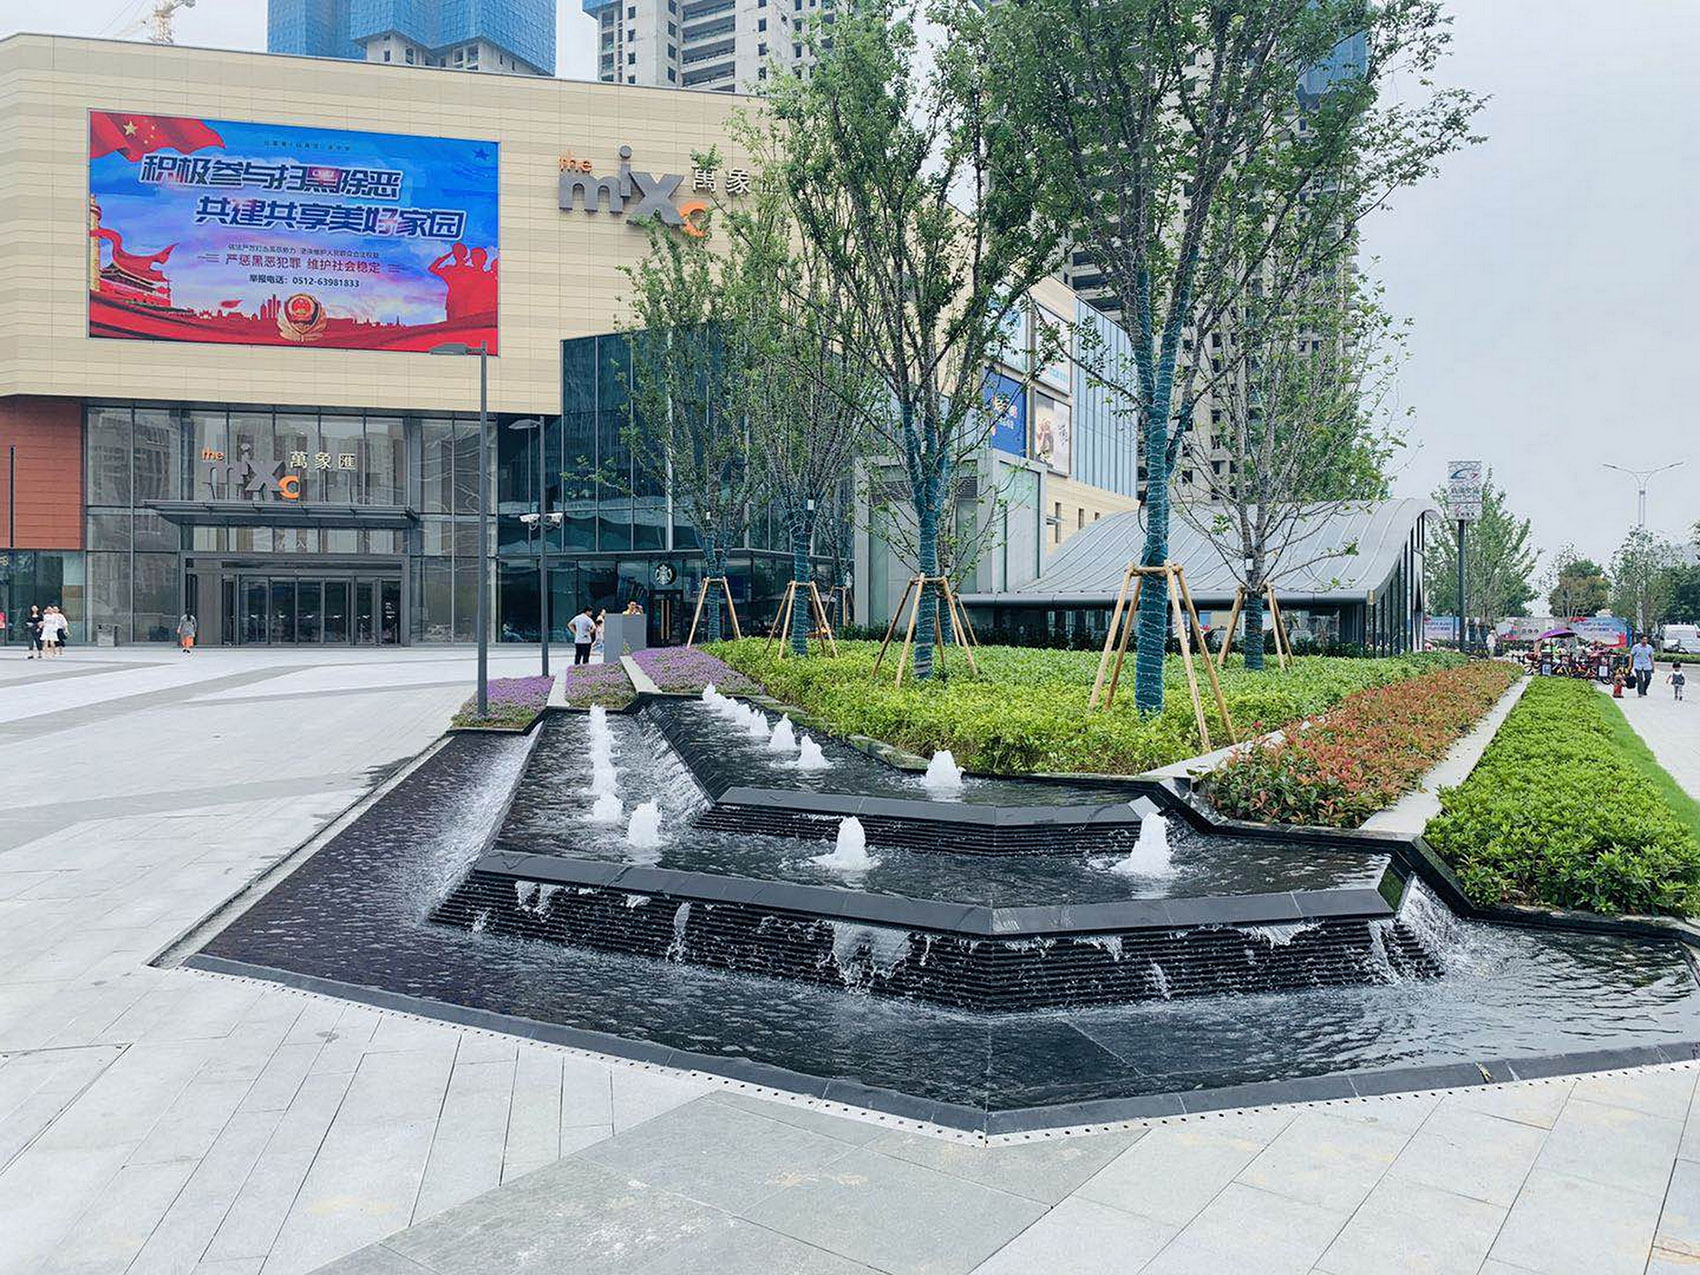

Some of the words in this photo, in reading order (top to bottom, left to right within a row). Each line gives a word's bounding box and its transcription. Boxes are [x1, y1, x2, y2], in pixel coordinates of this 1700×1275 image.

[559, 151, 593, 172] the
[141, 154, 402, 200] 积极参与扫黑除恶
[196, 195, 466, 239] 共建共享美好家园
[225, 253, 301, 270] 严惩黑恶犯罪
[307, 257, 380, 274] 维护社会稳定
[202, 446, 225, 461] the
[290, 451, 356, 470] 萬象匯
